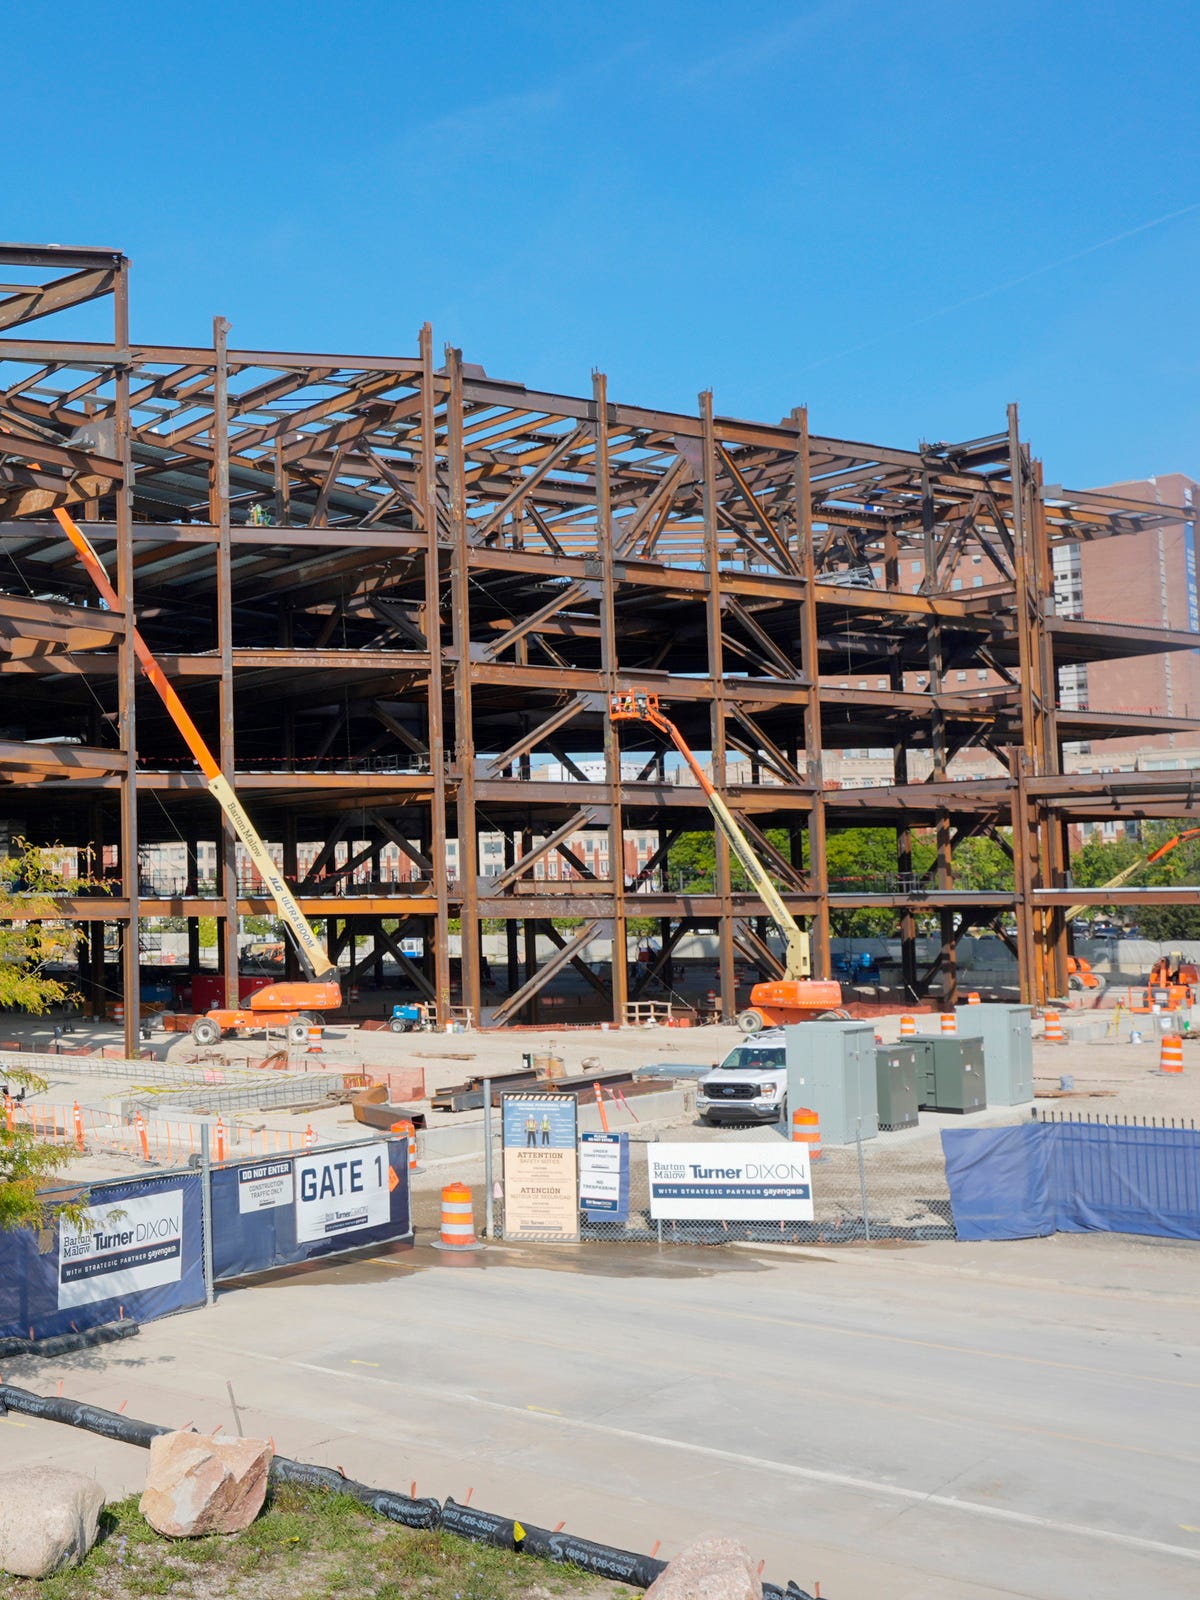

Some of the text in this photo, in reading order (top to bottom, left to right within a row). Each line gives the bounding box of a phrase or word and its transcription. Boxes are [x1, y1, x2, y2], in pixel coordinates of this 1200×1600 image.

[226, 802, 262, 858] Barton Malow
[269, 876, 284, 892] JLG
[281, 896, 315, 949] ULTRA BOOM
[517, 1151, 563, 1159] ATTENTION
[242, 1163, 289, 1180] DO NOT ENTER
[653, 1162, 685, 1171] Barton
[654, 1171, 686, 1179] Malow
[689, 1163, 805, 1180] Turner DIXON
[249, 1180, 284, 1193] CONSTRUCTION
[301, 1155, 382, 1203] GATE 1
[250, 1187, 283, 1200] TRAFFIC ONLY
[63, 1234, 92, 1247] Barton
[93, 1216, 179, 1251] Turner DIXON
[63, 1245, 91, 1258] Malow
[66, 1267, 81, 1277] WITH
[84, 1260, 118, 1273] STRATEGIC
[120, 1253, 147, 1265] PARTNER
[461, 1514, 498, 1533] 426-3357
[590, 1557, 634, 1577] 426-3357
